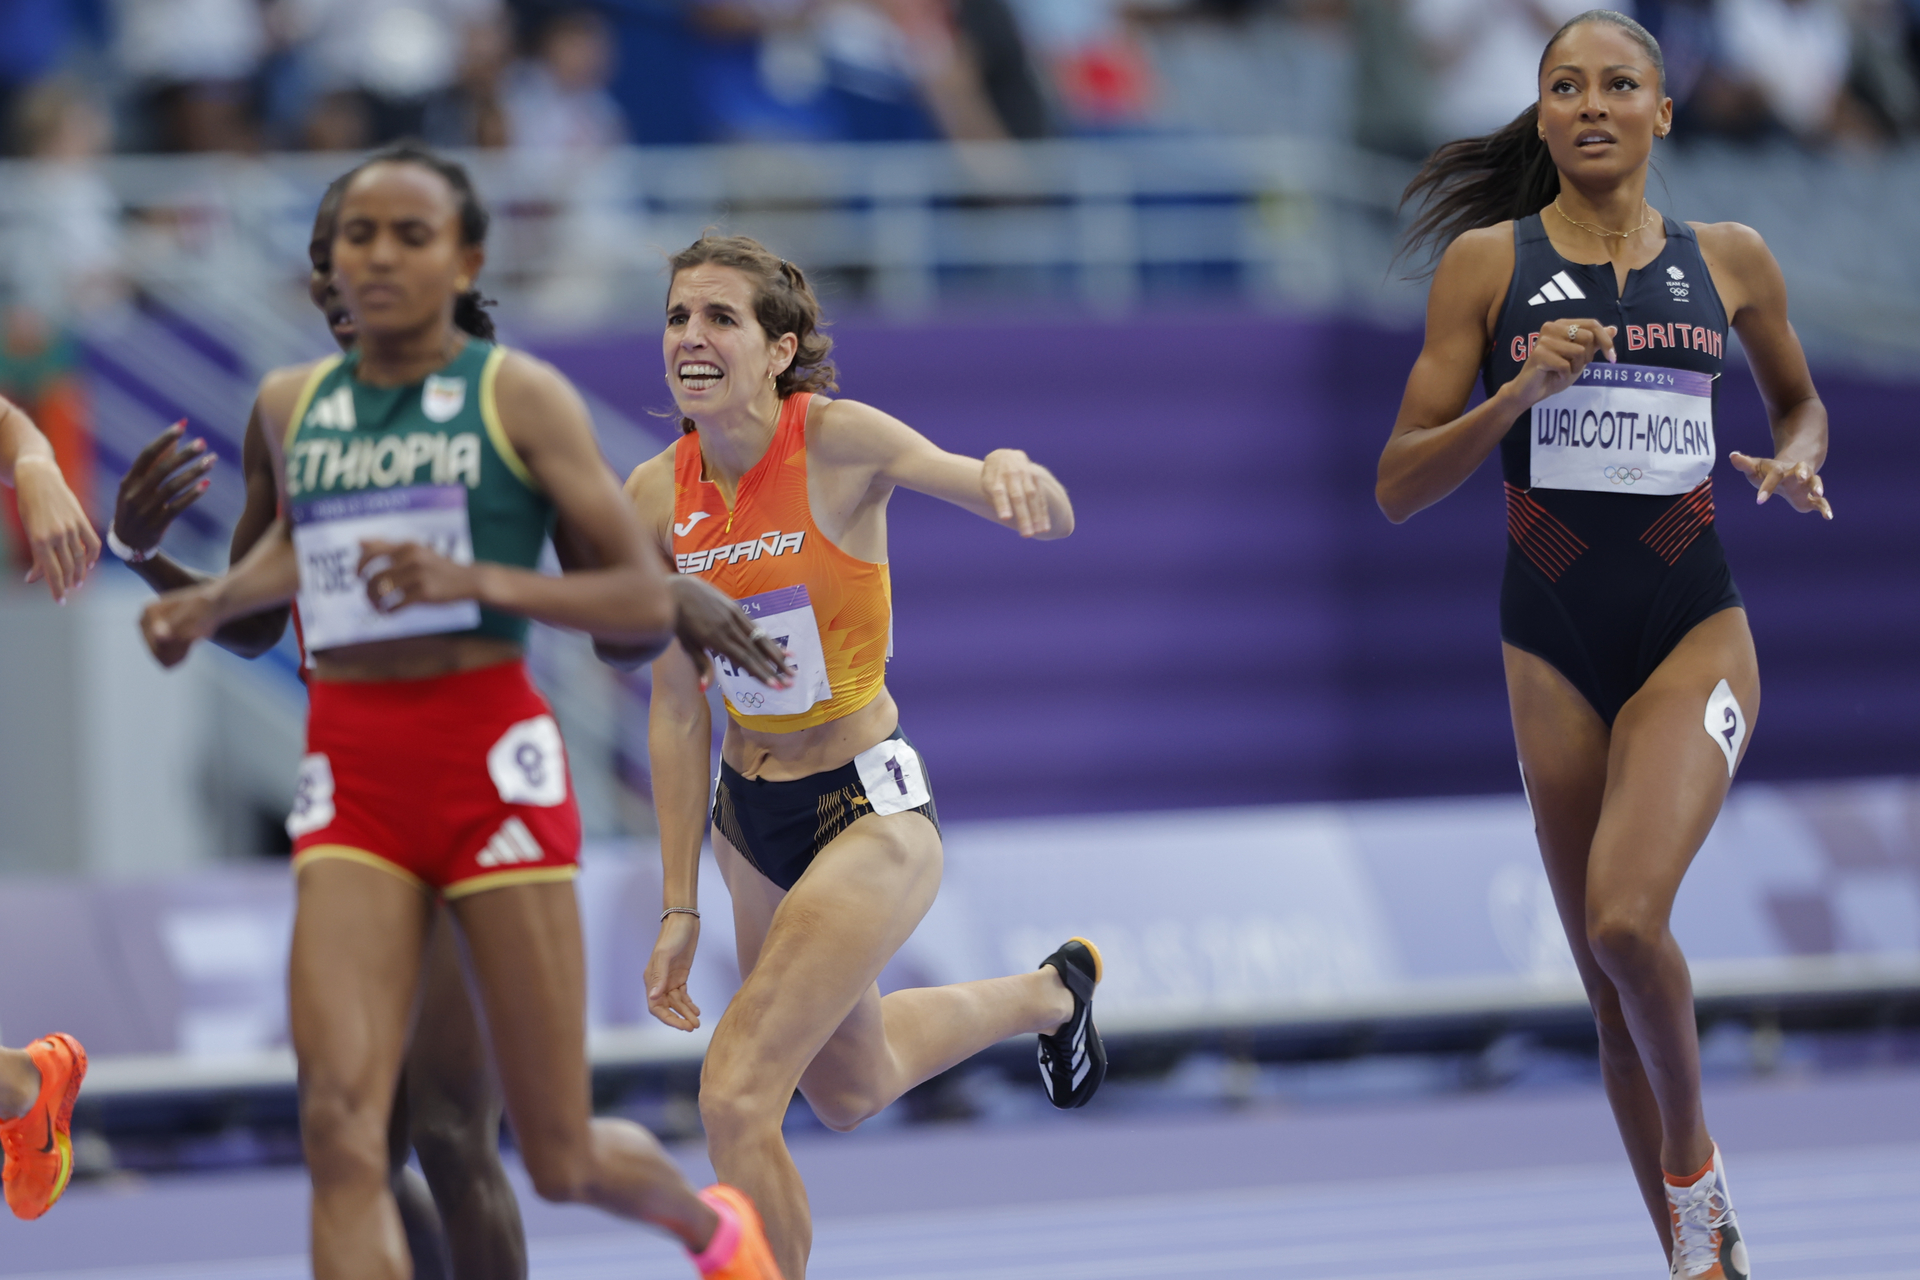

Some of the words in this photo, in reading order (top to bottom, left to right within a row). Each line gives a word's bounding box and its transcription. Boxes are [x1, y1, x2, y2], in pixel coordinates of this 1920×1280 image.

[1626, 322, 1722, 360] BRITAIN
[1537, 408, 1710, 456] WALCOTT-NOLAN
[675, 530, 806, 574] ESPAÑA
[1721, 706, 1737, 753] 2
[884, 754, 909, 796] 1
